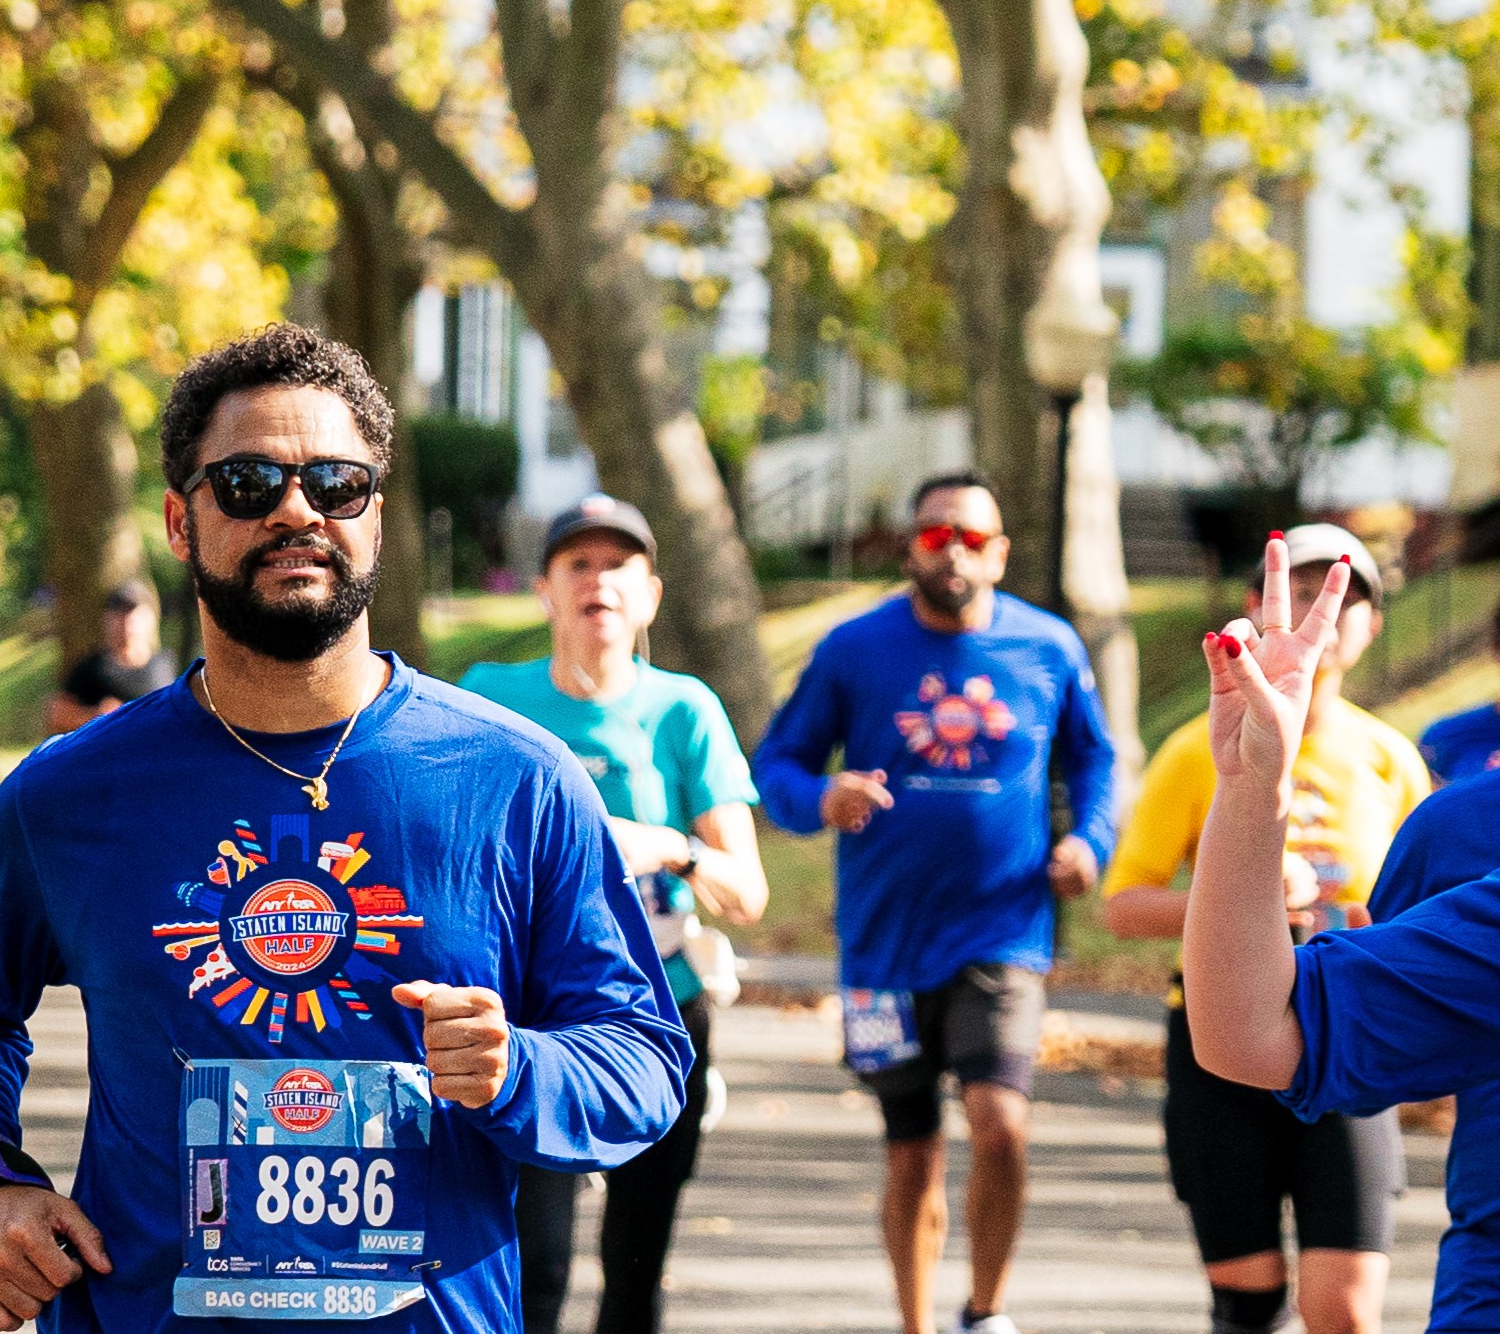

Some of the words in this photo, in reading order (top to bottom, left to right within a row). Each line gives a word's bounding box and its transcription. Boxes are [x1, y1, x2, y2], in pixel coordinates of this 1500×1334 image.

[237, 915, 286, 937] STATEN
[293, 915, 341, 932] ISLAND
[264, 938, 314, 955] HALF
[276, 962, 306, 971] 2024
[267, 1092, 301, 1107] STATEN
[305, 1093, 339, 1108] ISLAND
[285, 1108, 320, 1120] HALF
[200, 1163, 223, 1223] J
[256, 1155, 395, 1226] 8836
[361, 1235, 408, 1250] WAVE
[412, 1235, 422, 1251] 2
[205, 1291, 246, 1308] BAG
[250, 1291, 317, 1309] CHECK
[323, 1284, 377, 1315] 8836
